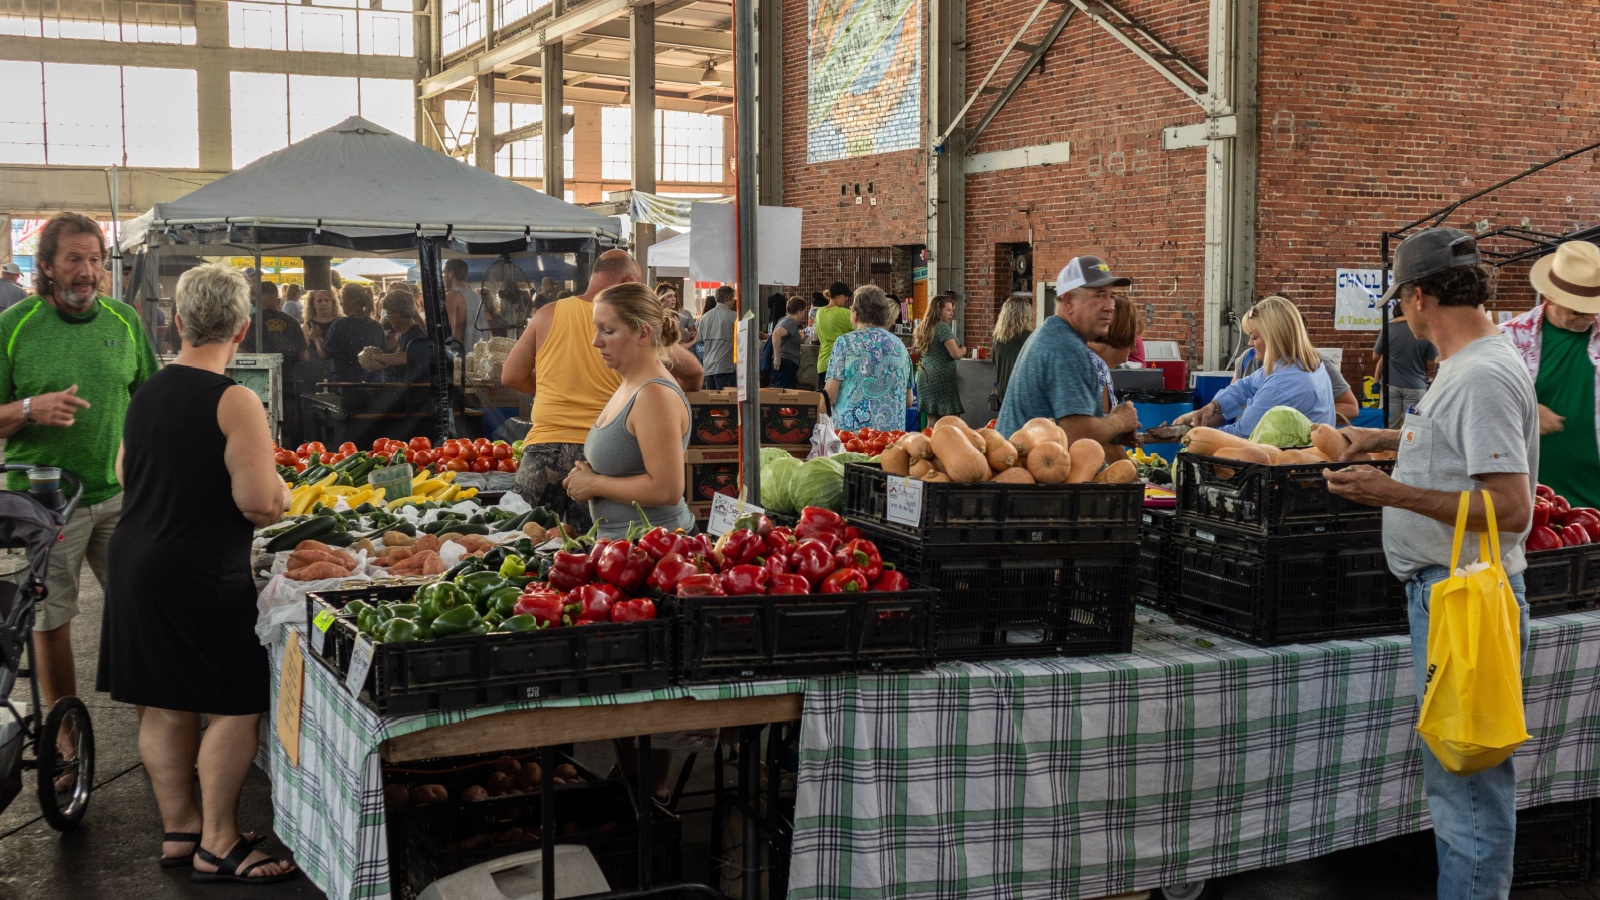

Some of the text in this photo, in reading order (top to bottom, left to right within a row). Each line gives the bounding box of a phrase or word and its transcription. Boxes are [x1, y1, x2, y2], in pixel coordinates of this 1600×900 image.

[1338, 273, 1393, 289] CHALL
[1338, 316, 1345, 325] A
[1348, 315, 1371, 325] Taste
